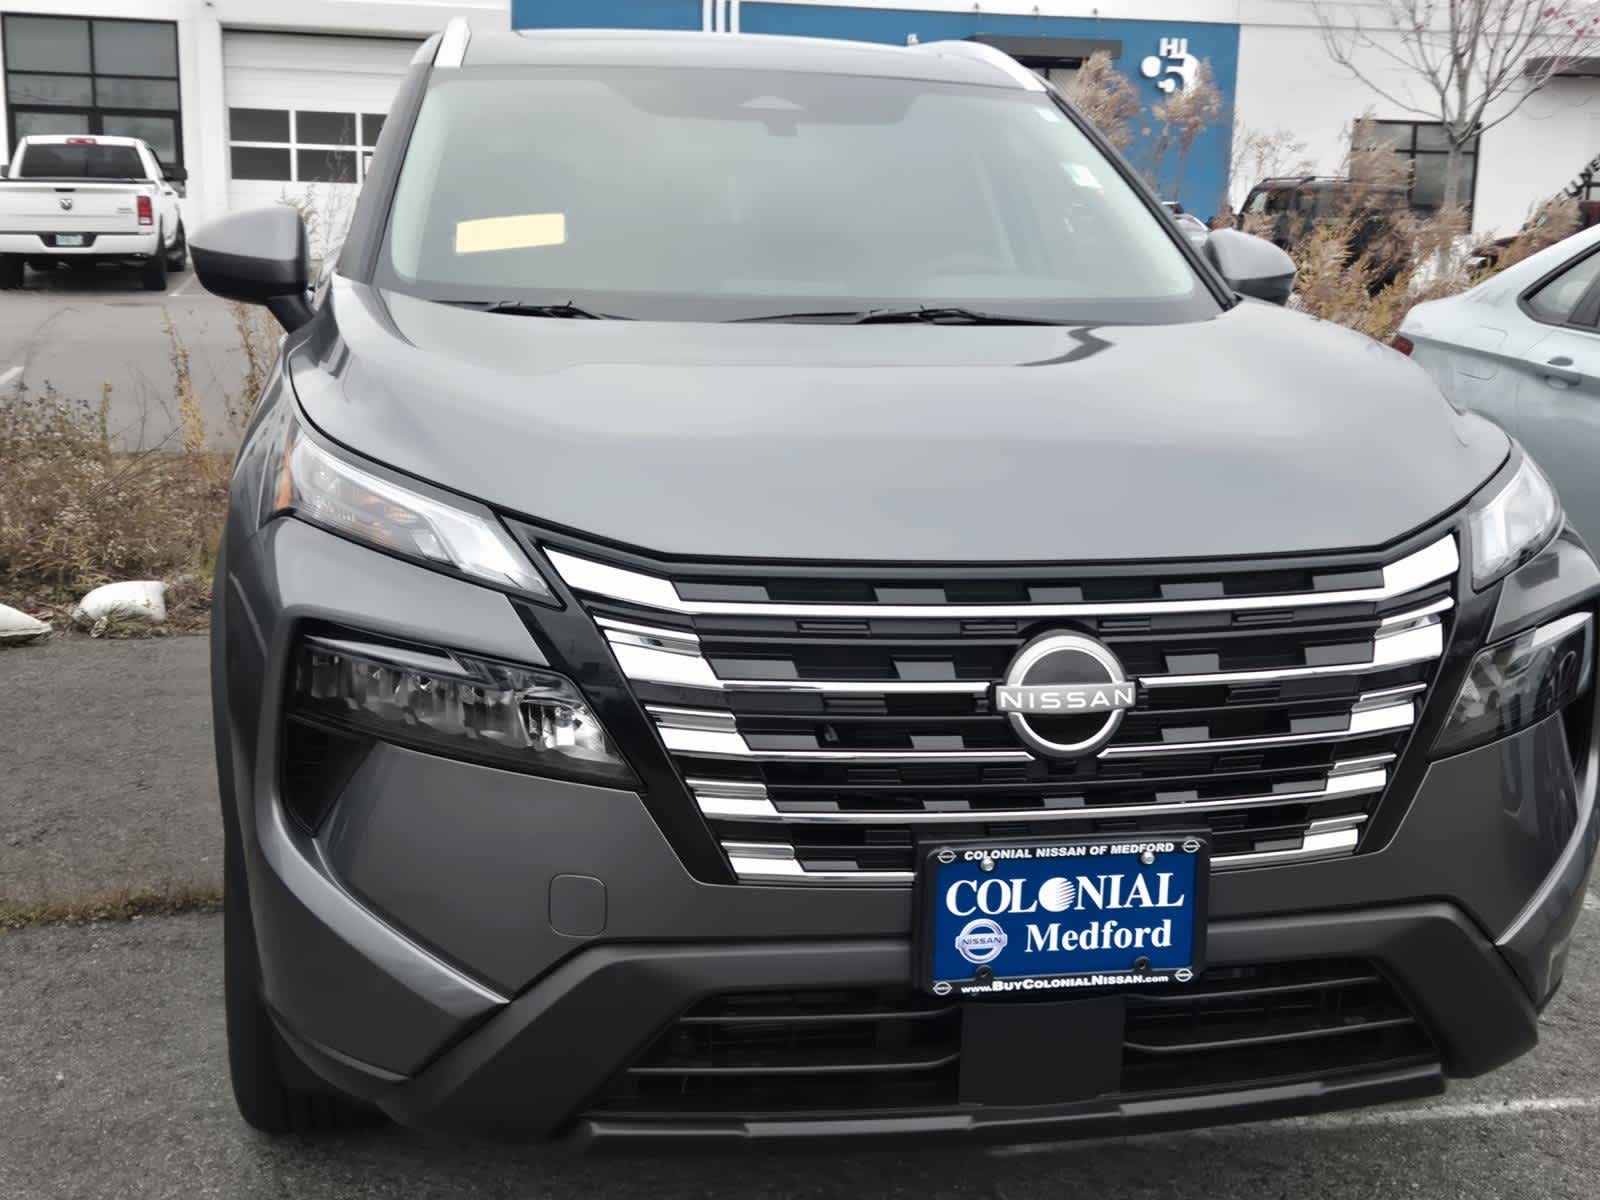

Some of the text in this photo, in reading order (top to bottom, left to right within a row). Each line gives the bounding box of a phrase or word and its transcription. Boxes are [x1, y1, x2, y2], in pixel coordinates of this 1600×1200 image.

[1159, 37, 1188, 57] HI
[1000, 687, 1133, 709] NISSAN
[964, 848, 1033, 861] COLONIAL
[1036, 846, 1086, 858] NISSAN
[1089, 845, 1108, 855] OF
[1110, 842, 1175, 854] MEDFORD
[945, 872, 1185, 916] COLONIAL
[962, 936, 1002, 945] NISSAN
[1024, 919, 1172, 952] Medford
